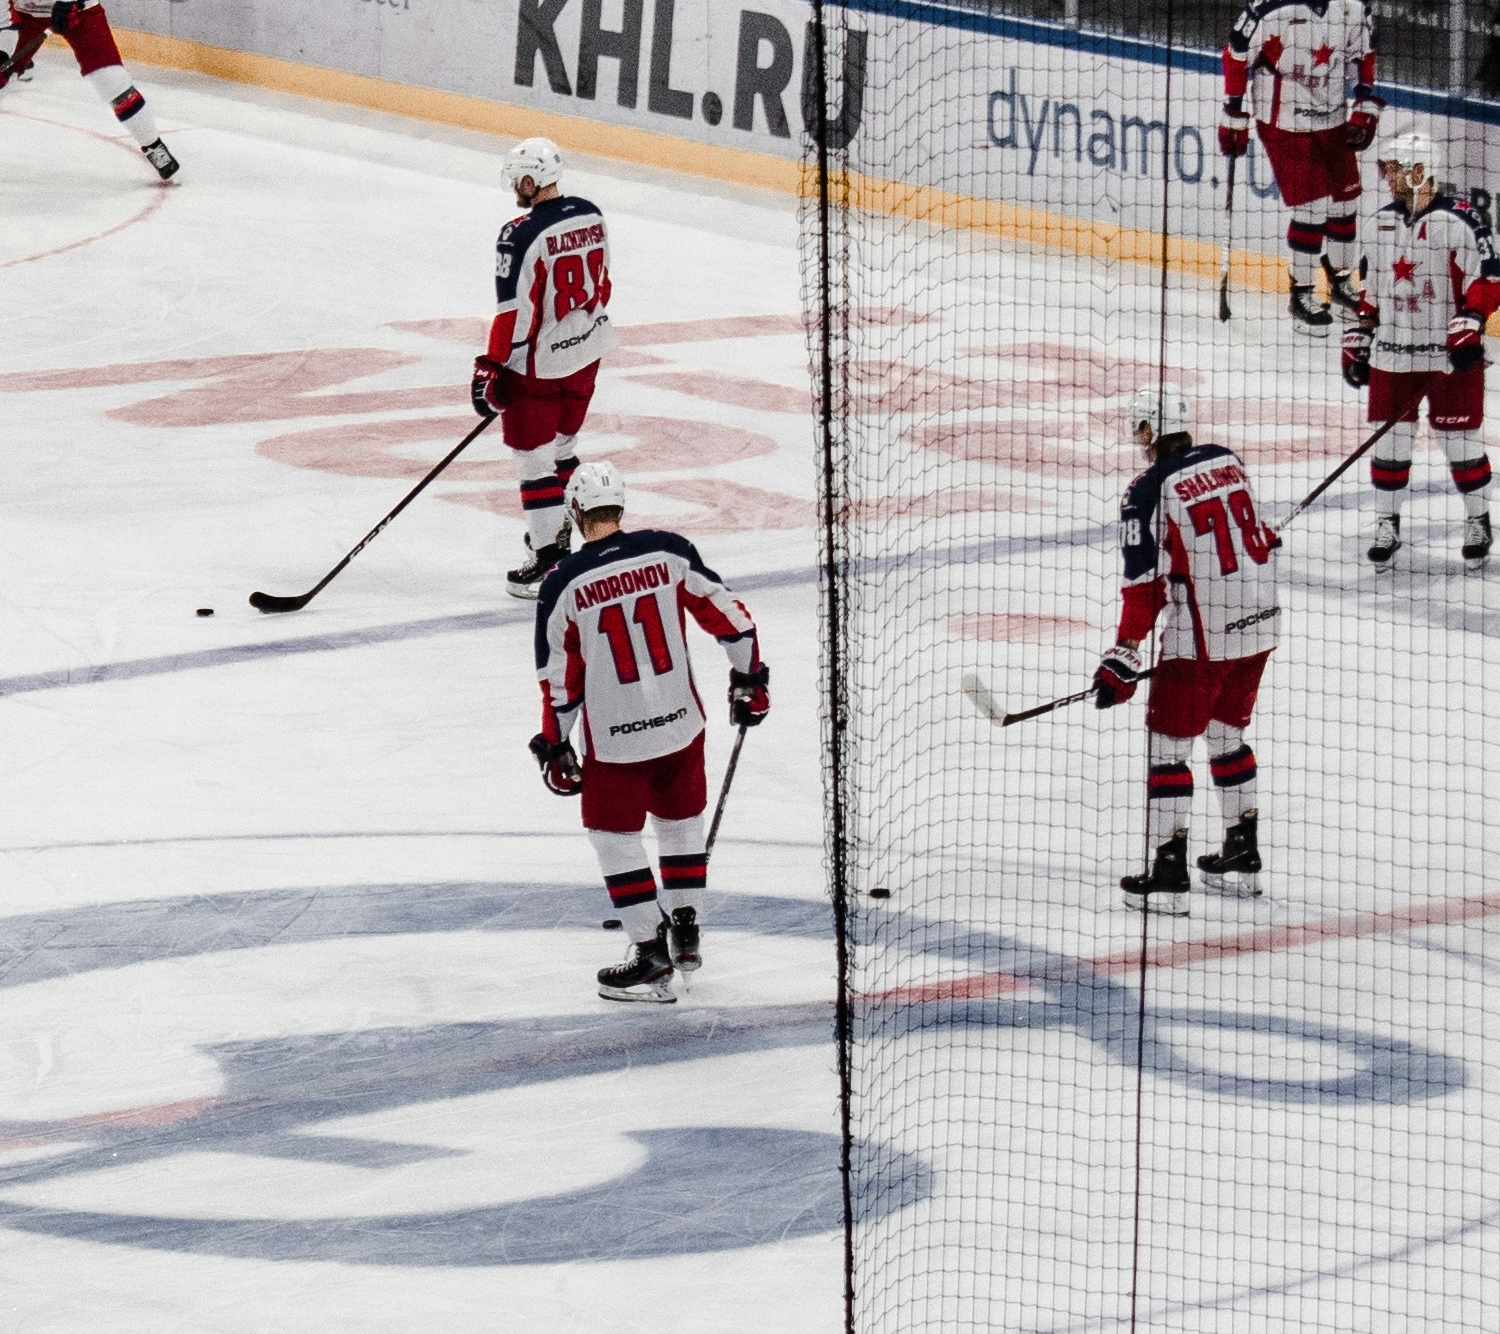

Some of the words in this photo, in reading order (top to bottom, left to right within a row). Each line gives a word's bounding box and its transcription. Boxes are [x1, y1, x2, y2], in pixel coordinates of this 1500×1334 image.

[986, 67, 1280, 201] dynamo.u
[1186, 488, 1270, 577] 78
[573, 561, 671, 612] ANDRONOV
[597, 592, 674, 685] 11
